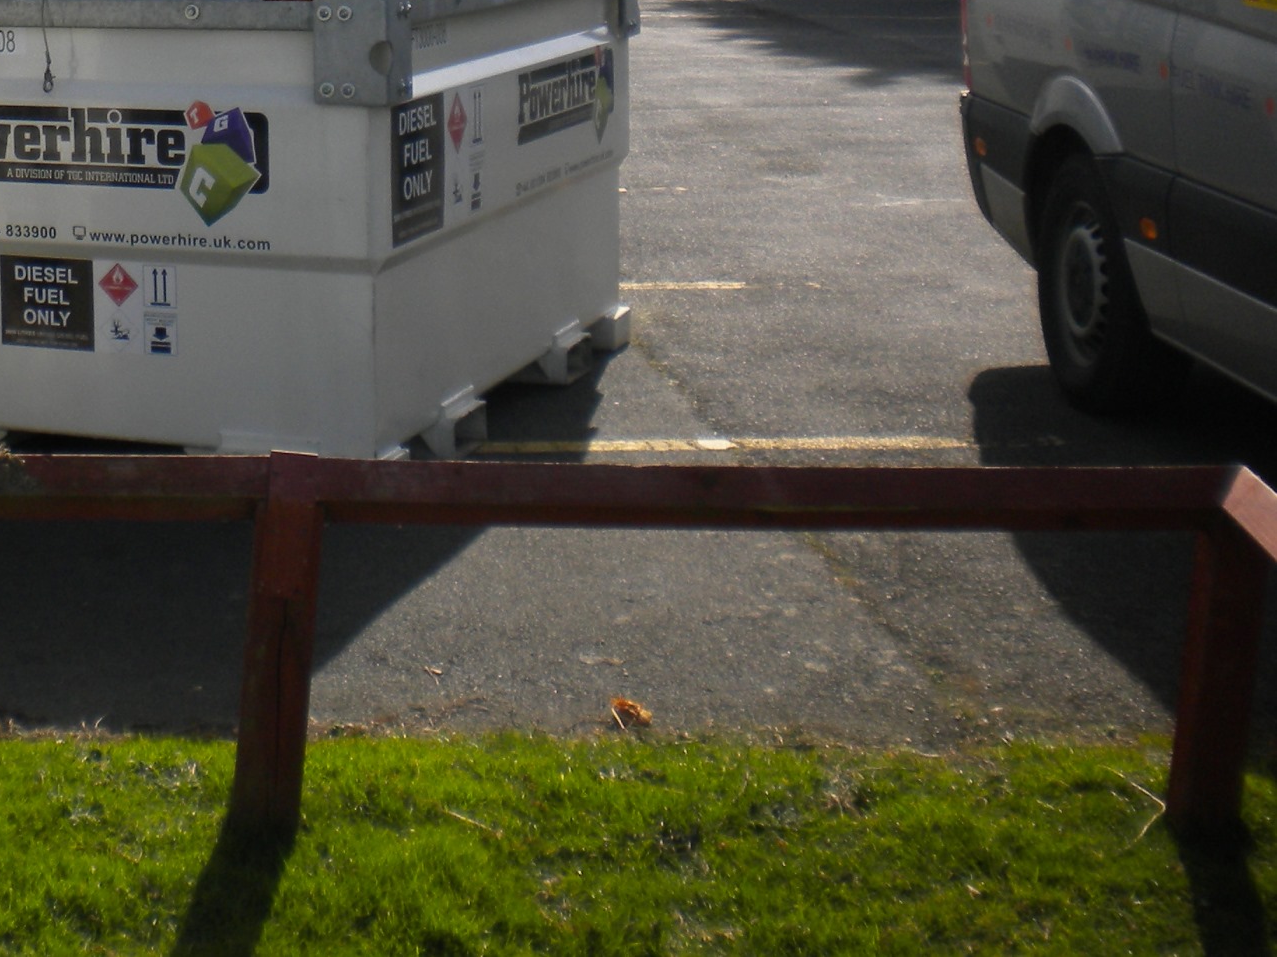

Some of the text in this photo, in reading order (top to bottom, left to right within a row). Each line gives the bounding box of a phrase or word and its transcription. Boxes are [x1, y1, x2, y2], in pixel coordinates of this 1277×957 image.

[398, 104, 437, 136] DIESEL
[404, 138, 433, 168] FUEL
[6, 168, 14, 178] A
[15, 168, 53, 180] DIVISION
[54, 169, 64, 180] OF
[85, 171, 156, 184] INTERNATIONAL
[157, 173, 174, 185] LTD
[403, 169, 434, 201] ONLY
[5, 224, 58, 240] 833900
[89, 230, 272, 252] www.powerhire.uk.com
[14, 265, 79, 285] DIESEL
[23, 287, 70, 306] FUEL
[23, 308, 72, 328] ONLY
